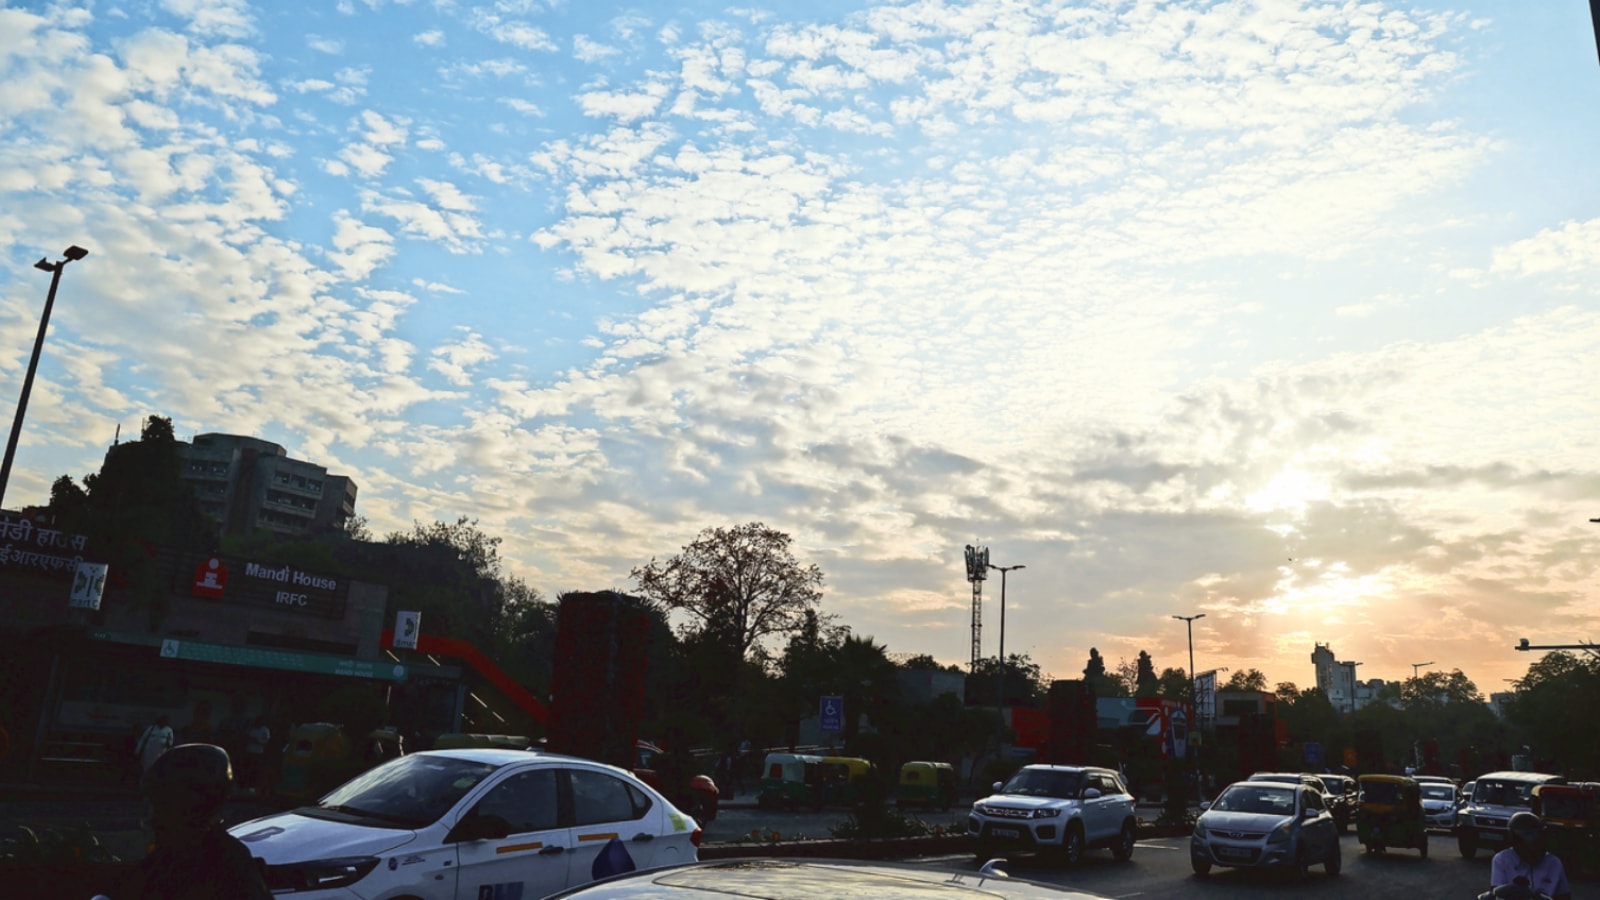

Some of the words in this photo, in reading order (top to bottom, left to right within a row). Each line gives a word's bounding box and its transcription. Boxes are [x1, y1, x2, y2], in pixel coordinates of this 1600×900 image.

[245, 562, 290, 583] Mandi
[292, 570, 336, 591] House
[275, 591, 308, 606] IRFC
